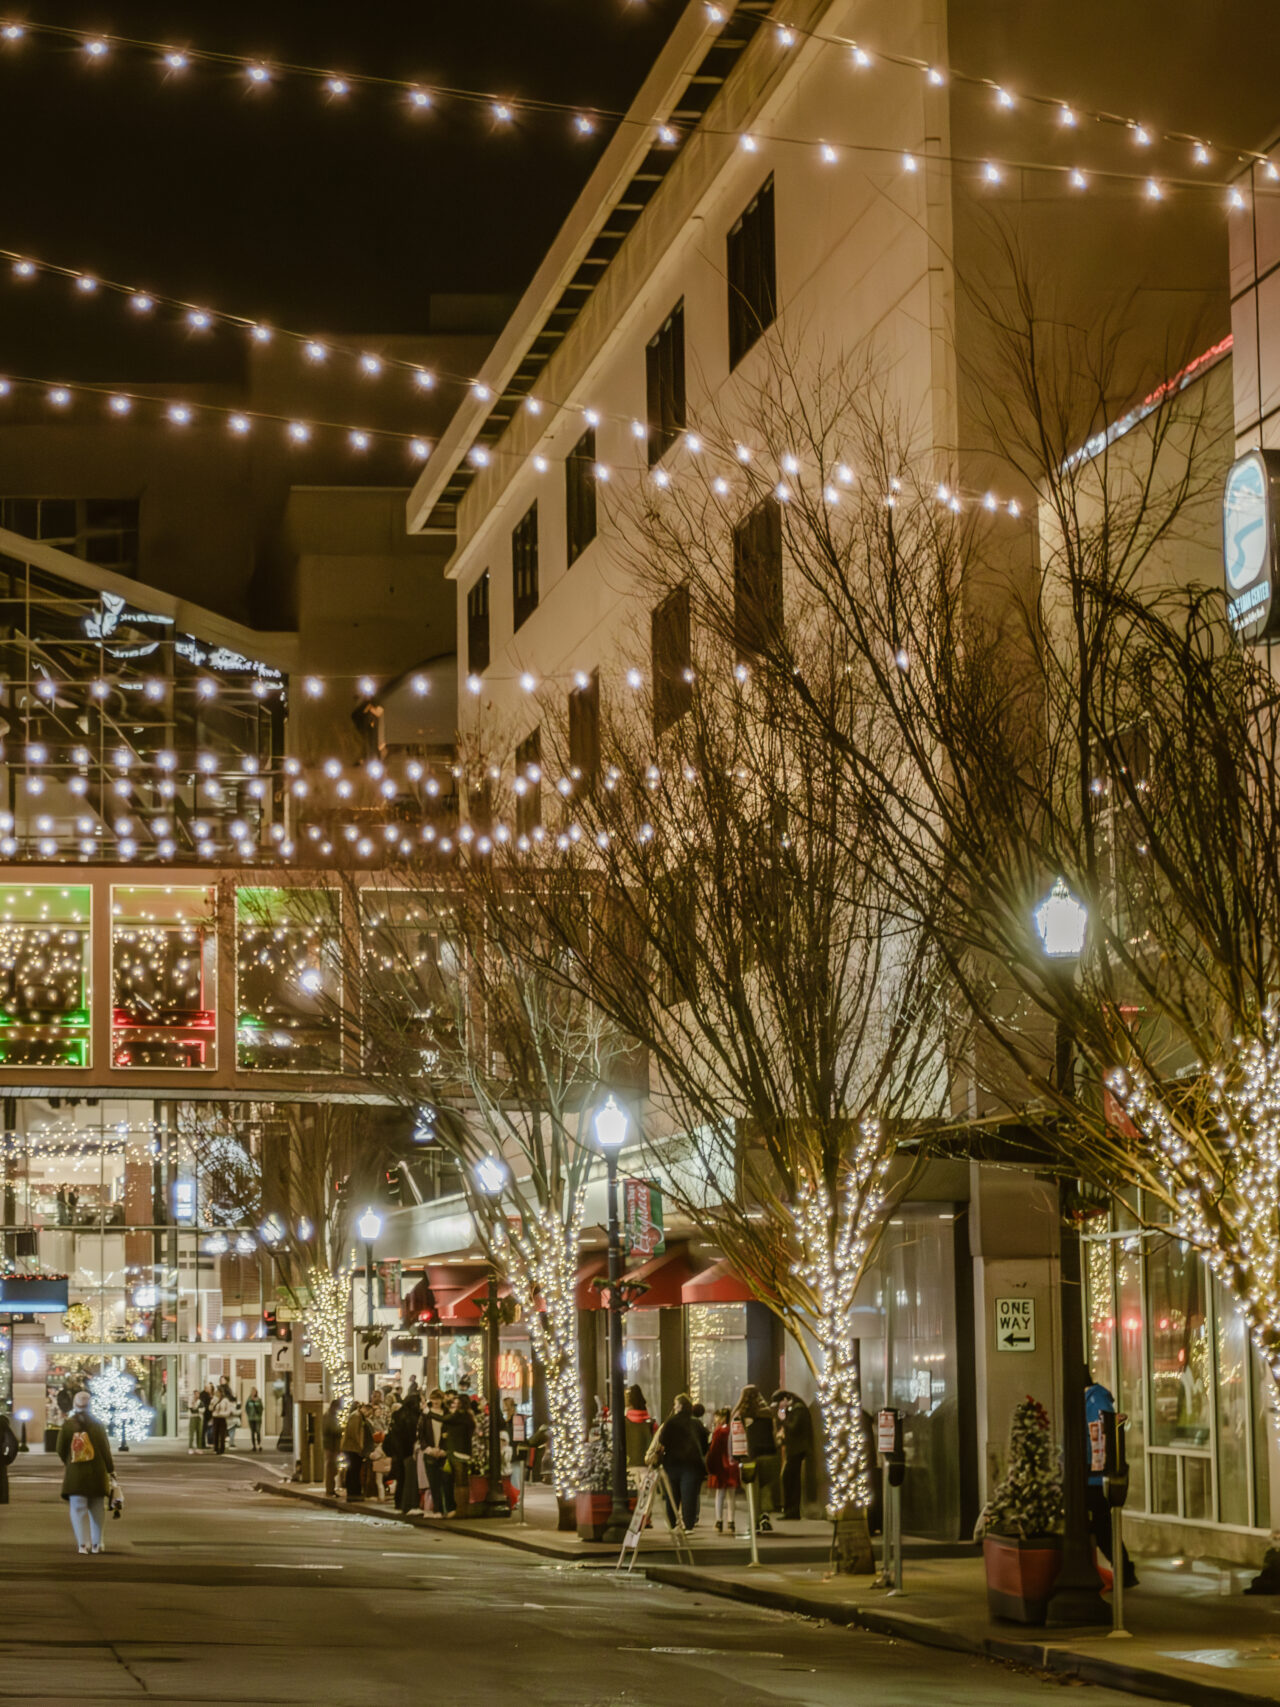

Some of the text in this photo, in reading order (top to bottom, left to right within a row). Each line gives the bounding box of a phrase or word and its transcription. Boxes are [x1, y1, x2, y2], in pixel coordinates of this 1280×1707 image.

[1000, 1302, 1030, 1315] ONE
[1000, 1317, 1031, 1330] WAY
[361, 1361, 385, 1371] ONLY
